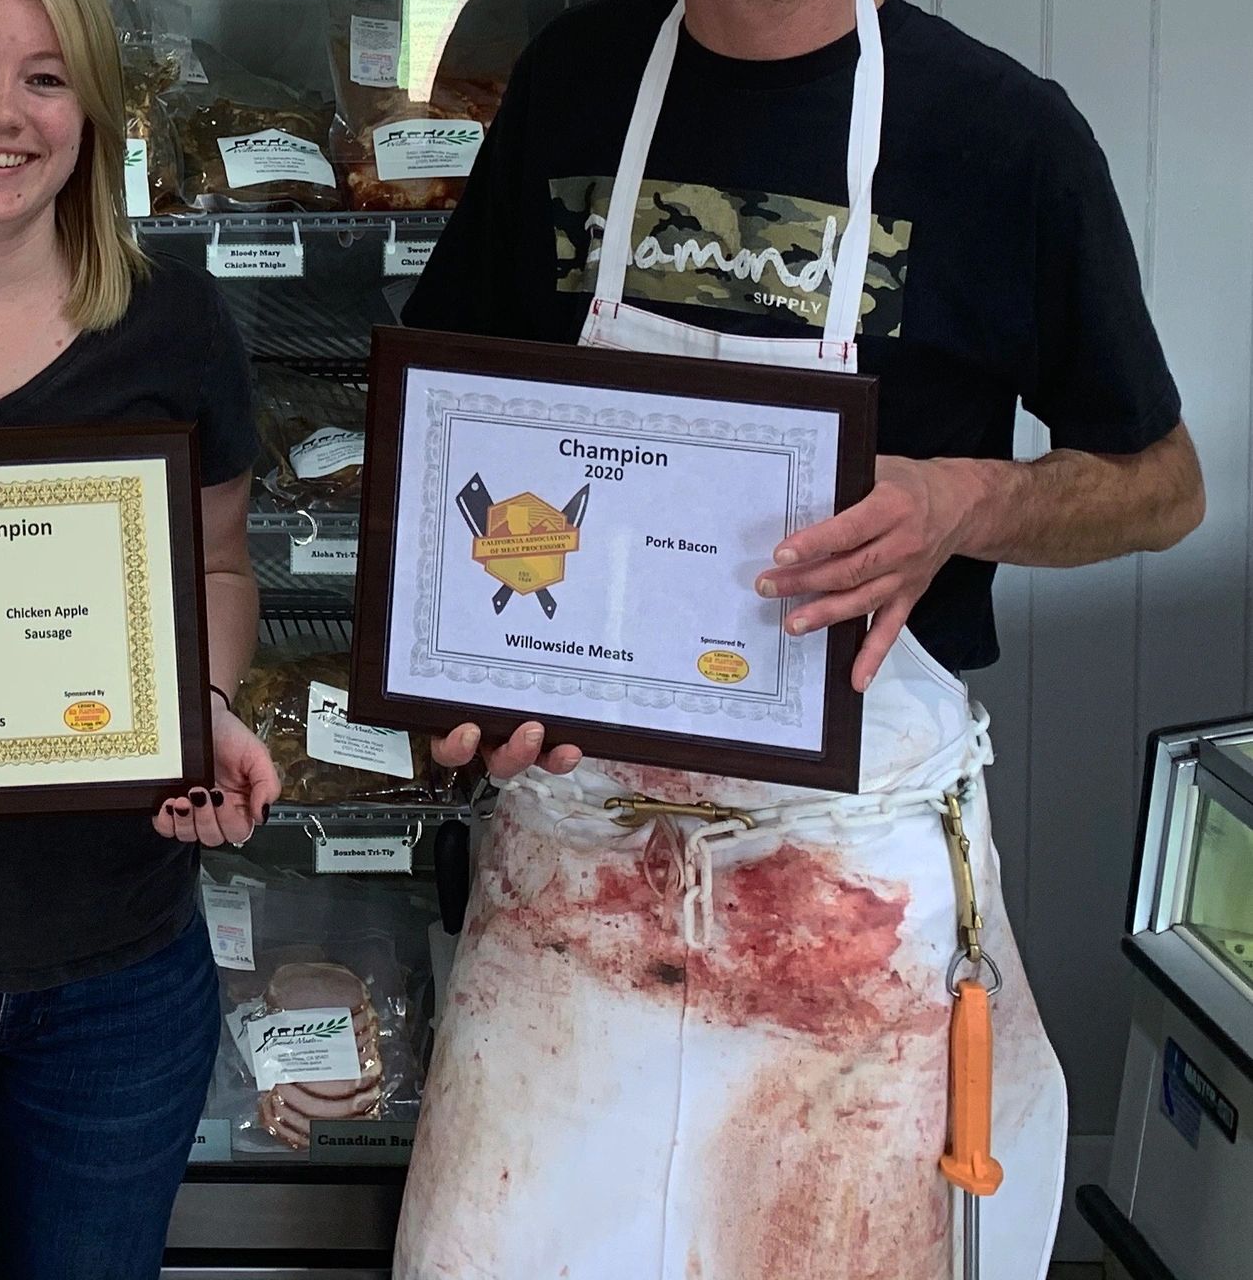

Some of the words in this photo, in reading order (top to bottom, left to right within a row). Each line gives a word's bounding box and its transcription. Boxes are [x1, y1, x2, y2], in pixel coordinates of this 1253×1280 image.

[230, 250, 258, 258] Bloody
[259, 250, 281, 258] Mary
[224, 261, 258, 269] Chicken
[259, 261, 286, 269] Thighs
[401, 258, 426, 266] Chick
[752, 291, 823, 315] SUPPLY
[558, 437, 669, 468] Champion
[584, 464, 625, 482] 2020
[481, 537, 523, 546] CALIFORNIA
[525, 534, 571, 543] ASSOCIATION
[645, 535, 675, 551] Pork
[678, 538, 719, 555] Bacon
[521, 543, 566, 552] PROCESSORS
[311, 550, 334, 558] Aloha
[5, 605, 52, 620] Chicken
[54, 604, 89, 621] Apple
[24, 626, 72, 642] Sausage
[504, 633, 584, 657] Willowside
[588, 643, 635, 663] Meats
[700, 636, 736, 647] Sponsored
[736, 640, 746, 649] By
[64, 689, 96, 699] Sponsored
[97, 689, 105, 697] By
[333, 848, 366, 856] Bourbon
[367, 848, 395, 857] Tri-Tip
[317, 1135, 386, 1147] Canadian
[390, 1135, 414, 1147] Bac
